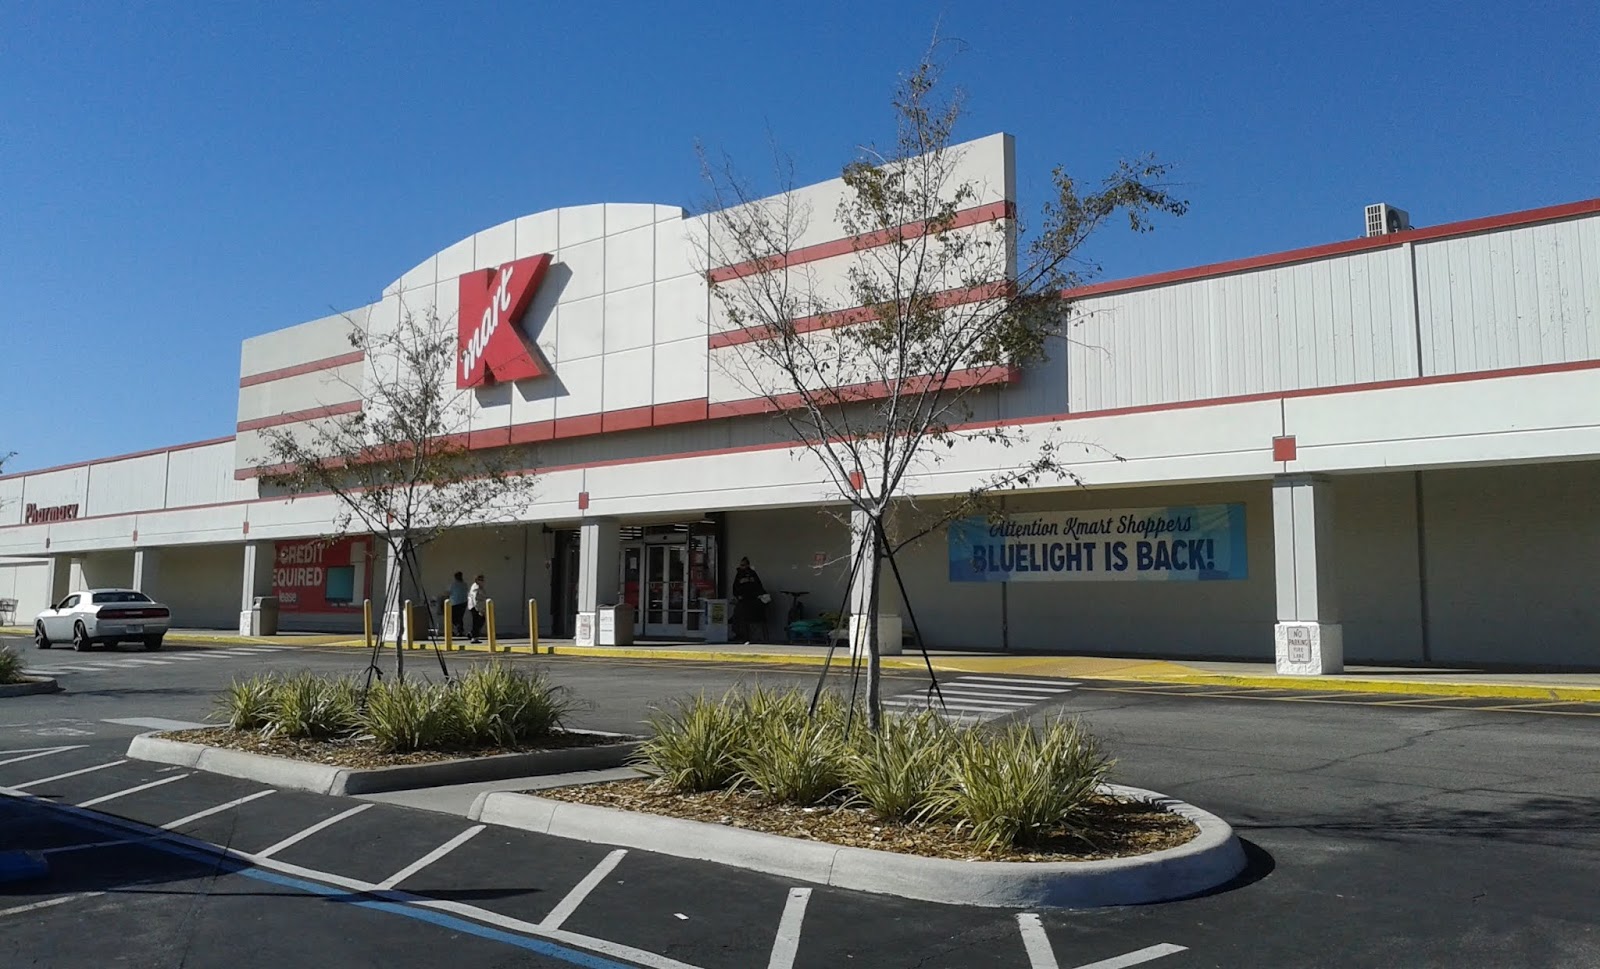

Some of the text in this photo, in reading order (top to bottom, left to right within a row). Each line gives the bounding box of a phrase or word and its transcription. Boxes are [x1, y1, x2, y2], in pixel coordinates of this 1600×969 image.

[25, 503, 79, 524] Pharmacy
[989, 514, 1192, 540] Attention Kmart Shoppers
[279, 543, 325, 564] CREDIT
[973, 538, 1215, 573] BLUELIGHT IS BACK!
[272, 566, 323, 587] EQUIRED
[1293, 630, 1303, 638] NO
